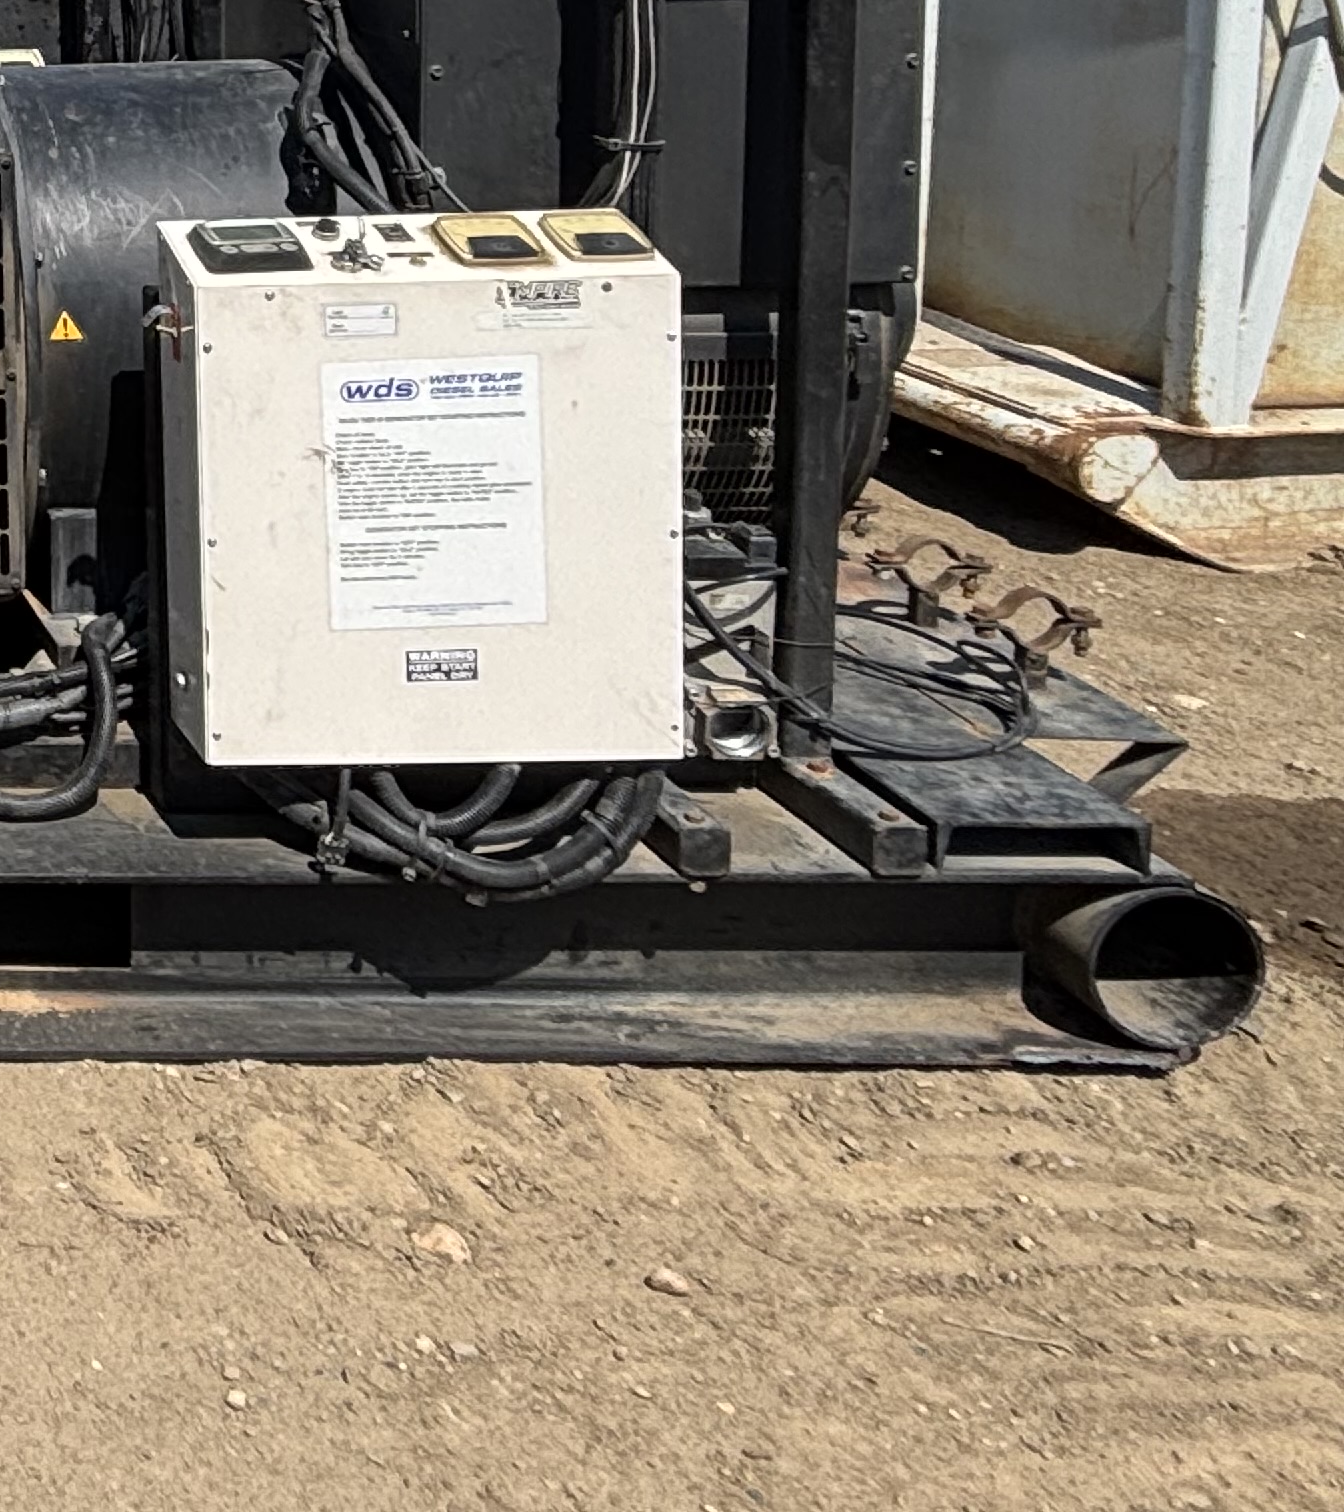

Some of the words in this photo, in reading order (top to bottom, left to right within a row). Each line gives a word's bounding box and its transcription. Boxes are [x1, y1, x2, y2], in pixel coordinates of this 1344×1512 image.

[347, 377, 414, 399] wds
[429, 371, 523, 384] WESTQUIP
[408, 650, 476, 661] WARNING
